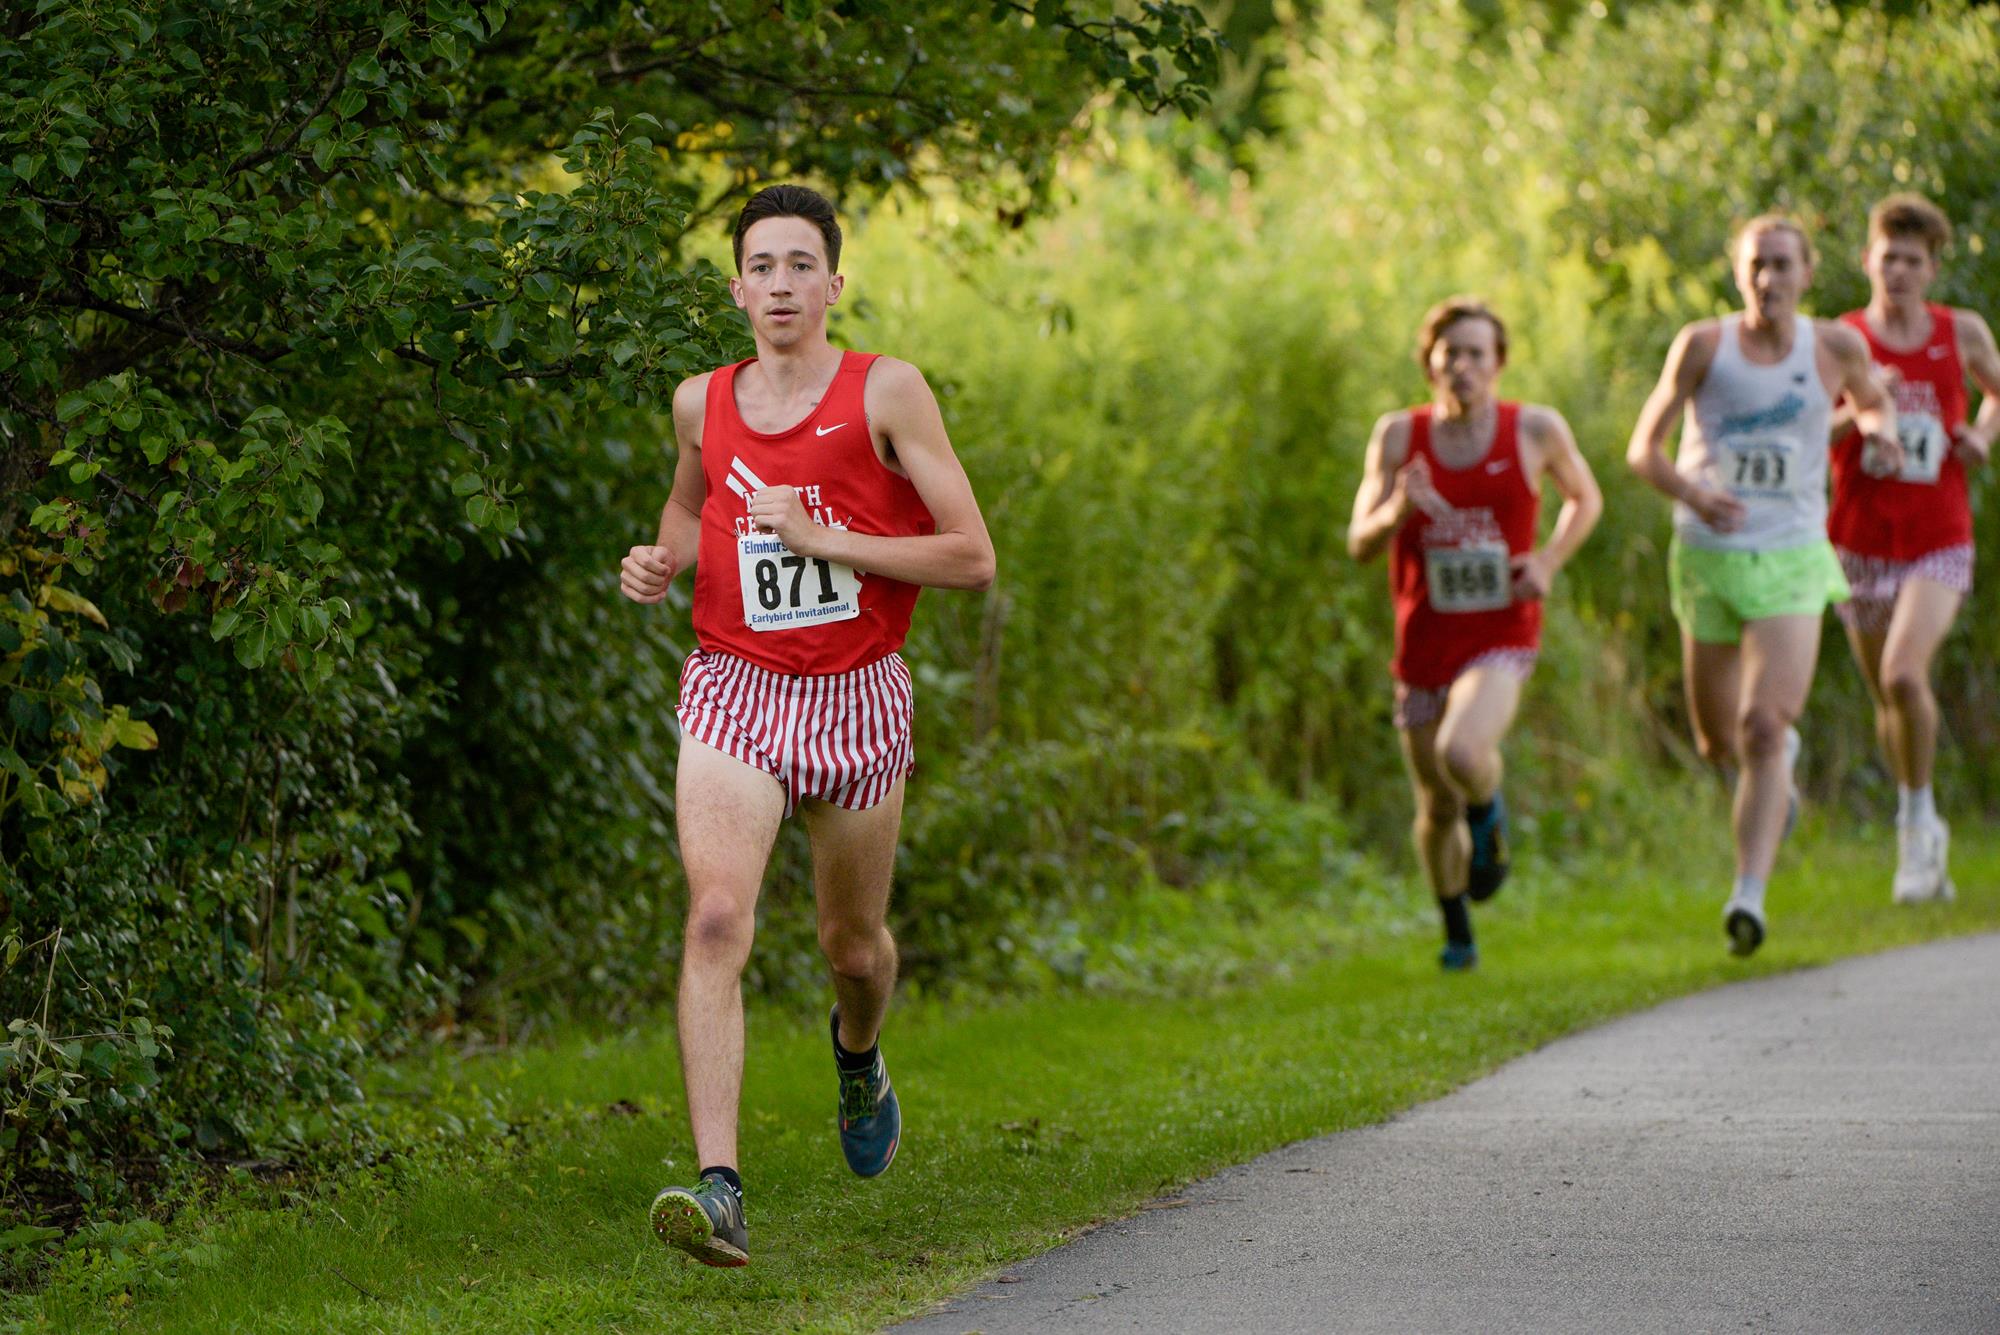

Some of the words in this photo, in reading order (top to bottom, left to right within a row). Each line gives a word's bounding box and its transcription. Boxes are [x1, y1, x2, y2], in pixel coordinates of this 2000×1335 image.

[745, 485, 822, 513] NTH
[736, 507, 841, 535] CEAL
[744, 540, 788, 554] Elmhurs
[755, 555, 839, 611] 871
[752, 611, 793, 624] Earlybird
[795, 602, 850, 619] Invitational
